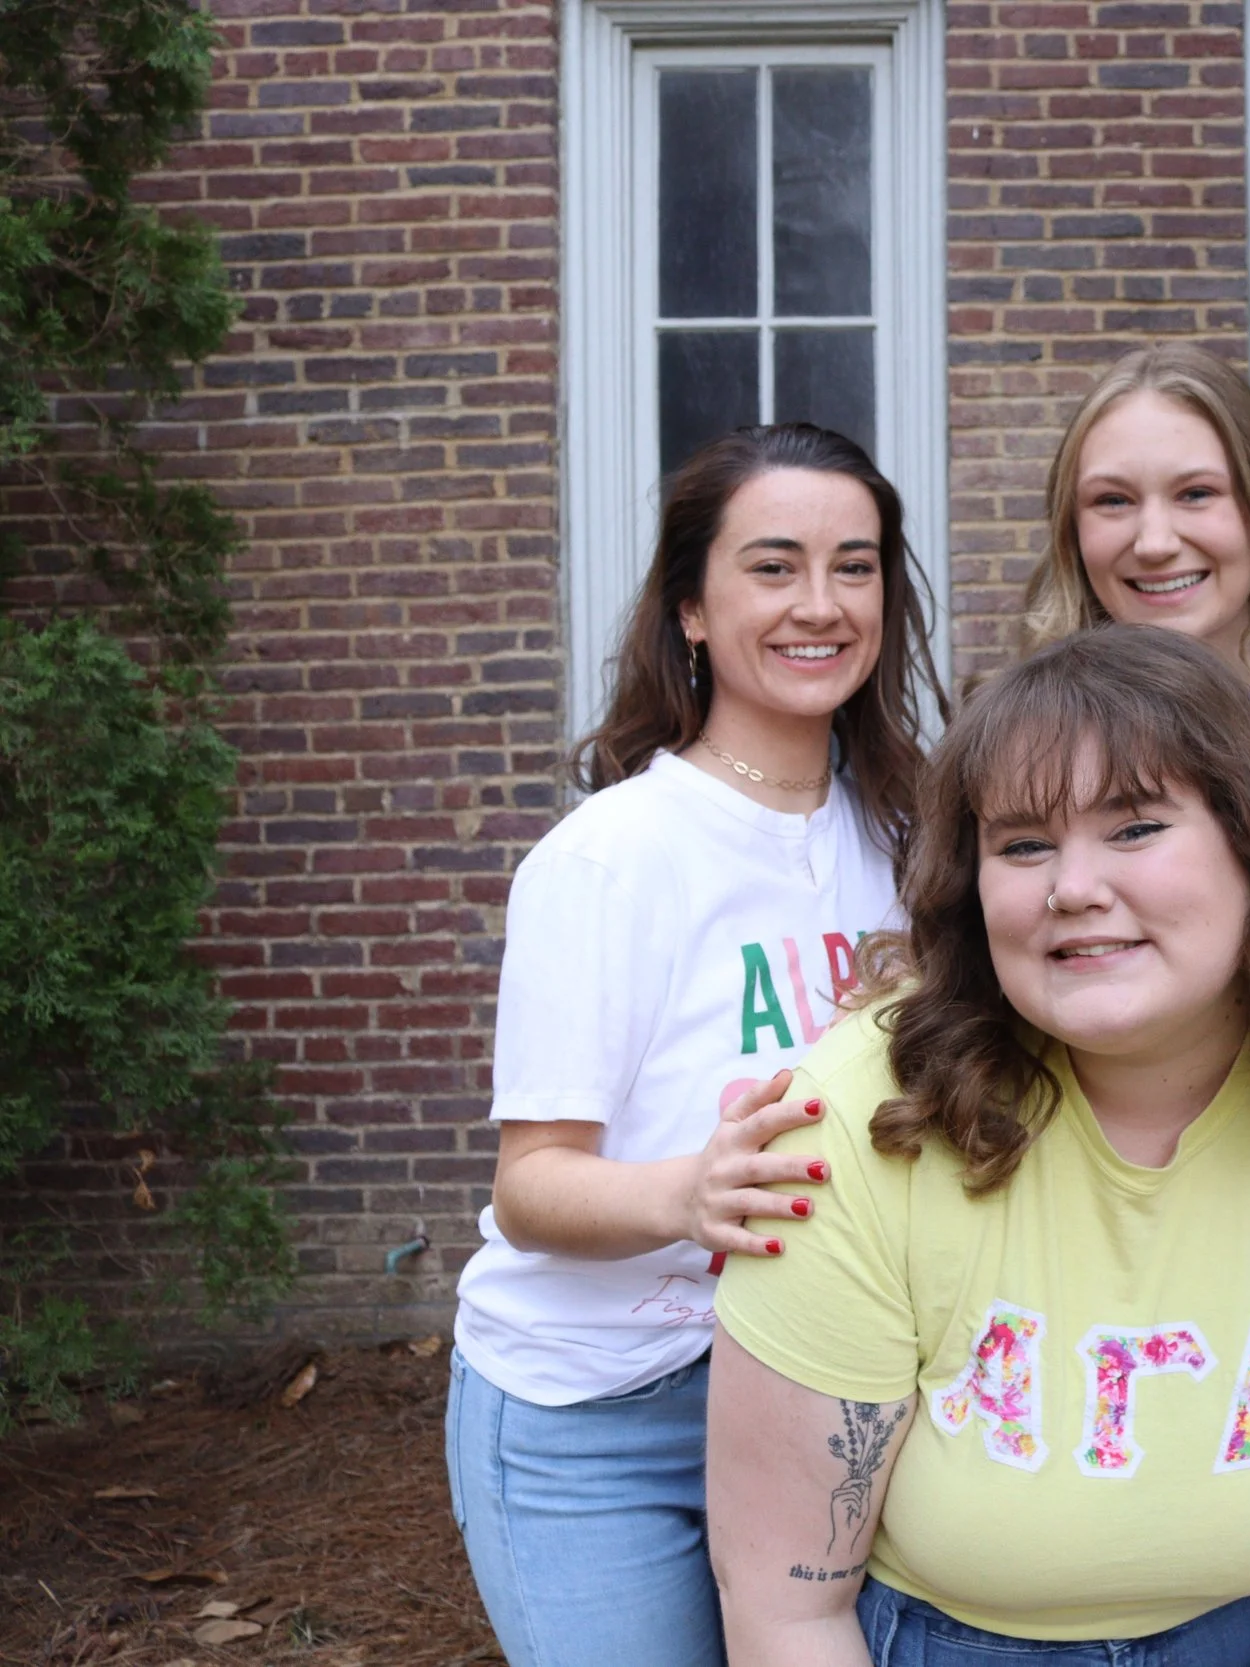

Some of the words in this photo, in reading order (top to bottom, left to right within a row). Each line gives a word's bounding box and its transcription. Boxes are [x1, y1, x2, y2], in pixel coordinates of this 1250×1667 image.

[741, 930, 866, 1055] ALP
[789, 1563, 814, 1581] this
[817, 1567, 828, 1582] is
